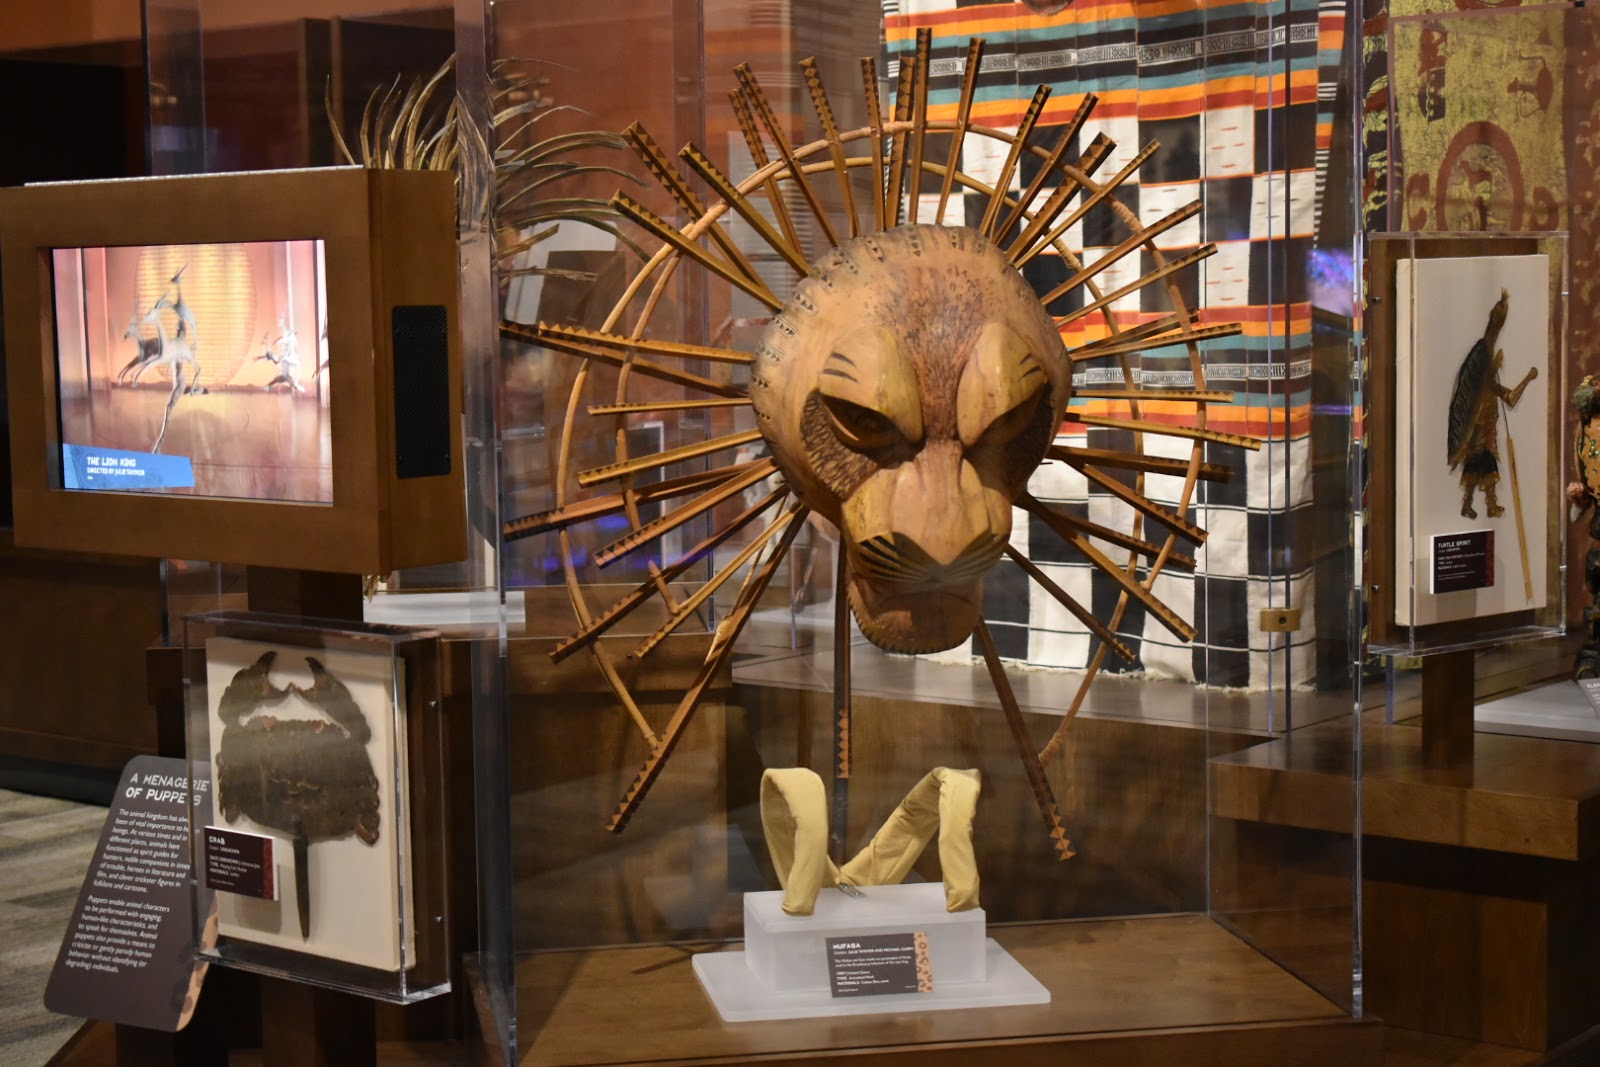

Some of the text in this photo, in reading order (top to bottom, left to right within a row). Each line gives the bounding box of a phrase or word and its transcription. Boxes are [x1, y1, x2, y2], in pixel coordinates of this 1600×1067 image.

[87, 457, 136, 467] THE LION KING
[130, 773, 138, 783] A
[126, 787, 201, 806] OF PUPPES
[147, 822, 175, 831] importance
[209, 836, 225, 845] CRAB
[106, 844, 132, 853] functioned
[140, 848, 153, 857] spirit
[139, 858, 169, 867] companions
[151, 869, 175, 877] literature
[94, 880, 112, 888] folklore
[158, 878, 174, 887] figures
[88, 895, 107, 904] Puppets
[144, 903, 170, 912] characters
[99, 907, 126, 916] performed
[139, 930, 158, 939] Animal
[69, 950, 90, 959] behavior
[134, 950, 152, 958] human
